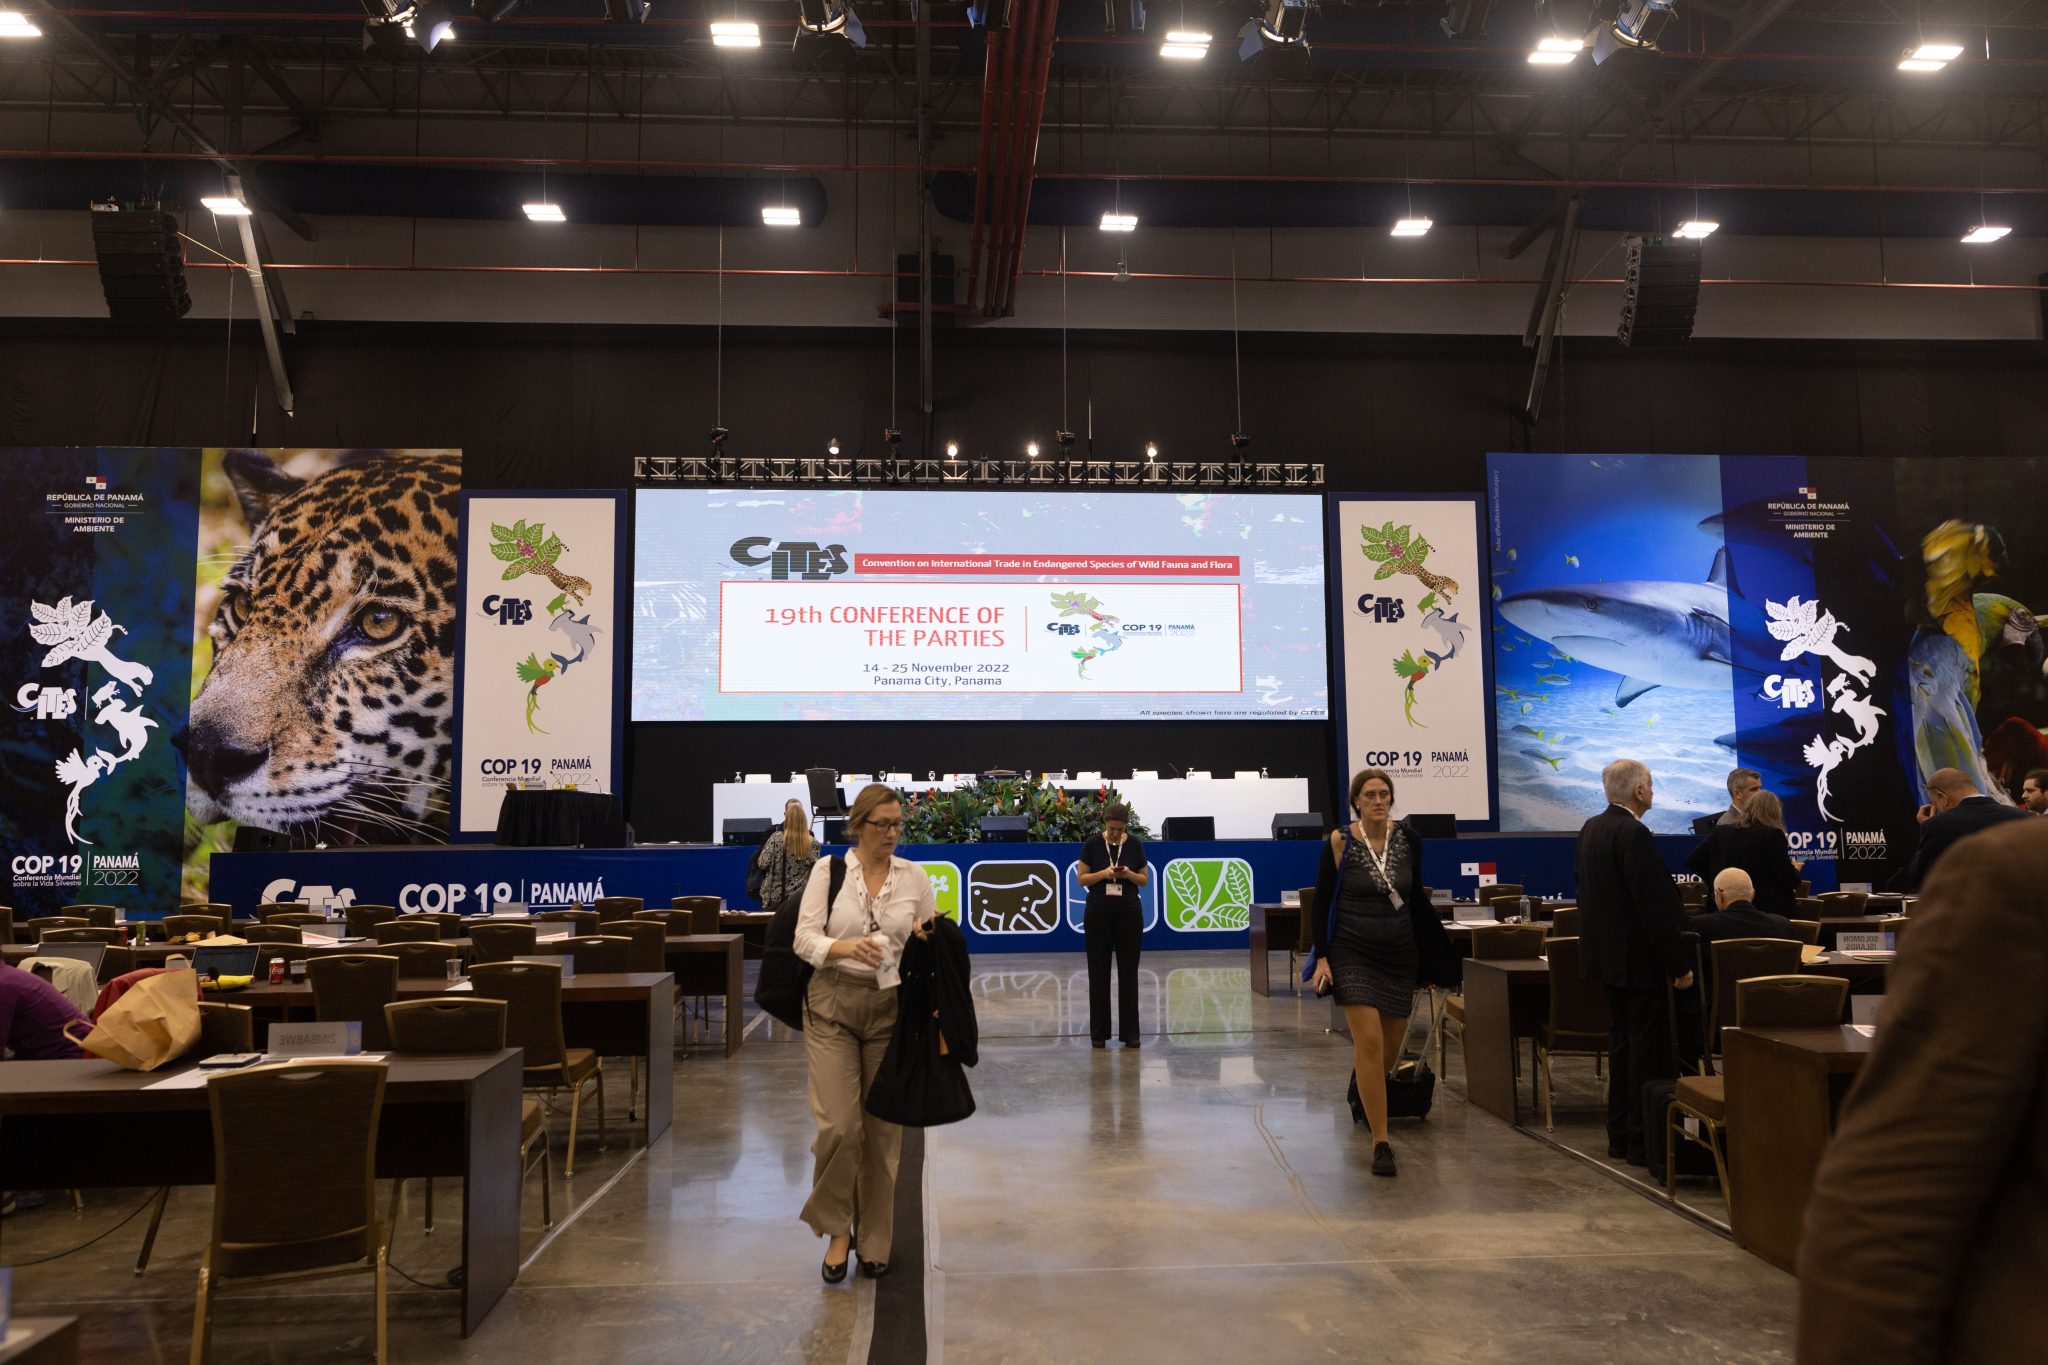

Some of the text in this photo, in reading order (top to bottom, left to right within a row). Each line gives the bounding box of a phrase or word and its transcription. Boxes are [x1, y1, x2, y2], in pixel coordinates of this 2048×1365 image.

[46, 493, 90, 501] REPÚBLICA
[107, 493, 144, 501] PANAMÁ
[1768, 502, 1806, 510] REPÚBLICA
[1818, 502, 1850, 510] PANAMÁ
[730, 536, 849, 580] CITES
[862, 559, 915, 568] Convention
[931, 559, 992, 568] International
[994, 559, 1020, 568] Trade
[1022, 560, 1031, 568] in
[1033, 560, 1088, 570] Endangered
[1089, 560, 1125, 570] Species
[1127, 560, 1138, 569] of
[1138, 560, 1160, 569] Wild
[1161, 561, 1189, 569] Fauna
[1191, 561, 1208, 569] and
[1210, 561, 1233, 569] Flora
[482, 594, 533, 625] CITES
[764, 606, 1005, 625] 19th CONFERENCE OF
[1357, 593, 1405, 623] CITES
[1046, 622, 1081, 636] CITES
[864, 629, 1005, 647] THE PARTIES
[863, 663, 880, 673] 14
[892, 663, 908, 673] 25
[911, 662, 972, 673] November
[976, 664, 1010, 673] 2022
[874, 675, 1002, 688] Panama City, Panama
[1763, 674, 1816, 709] CITES
[17, 682, 77, 720] CITES
[551, 755, 592, 770] PANAMÁ
[1365, 751, 1423, 767] COP 19
[1431, 749, 1469, 762] PANAMÁ
[481, 758, 542, 775] COP 19
[1432, 765, 1469, 778] 2022
[1785, 831, 1837, 849] OP 19
[1846, 829, 1886, 844] PANAMÁ
[93, 852, 140, 868] PANAMÁ
[1848, 845, 1887, 860] 2022
[11, 855, 82, 875] COP 19
[93, 870, 139, 886] 2022
[399, 882, 513, 914] COP 19
[531, 876, 605, 904] PANAMÁ
